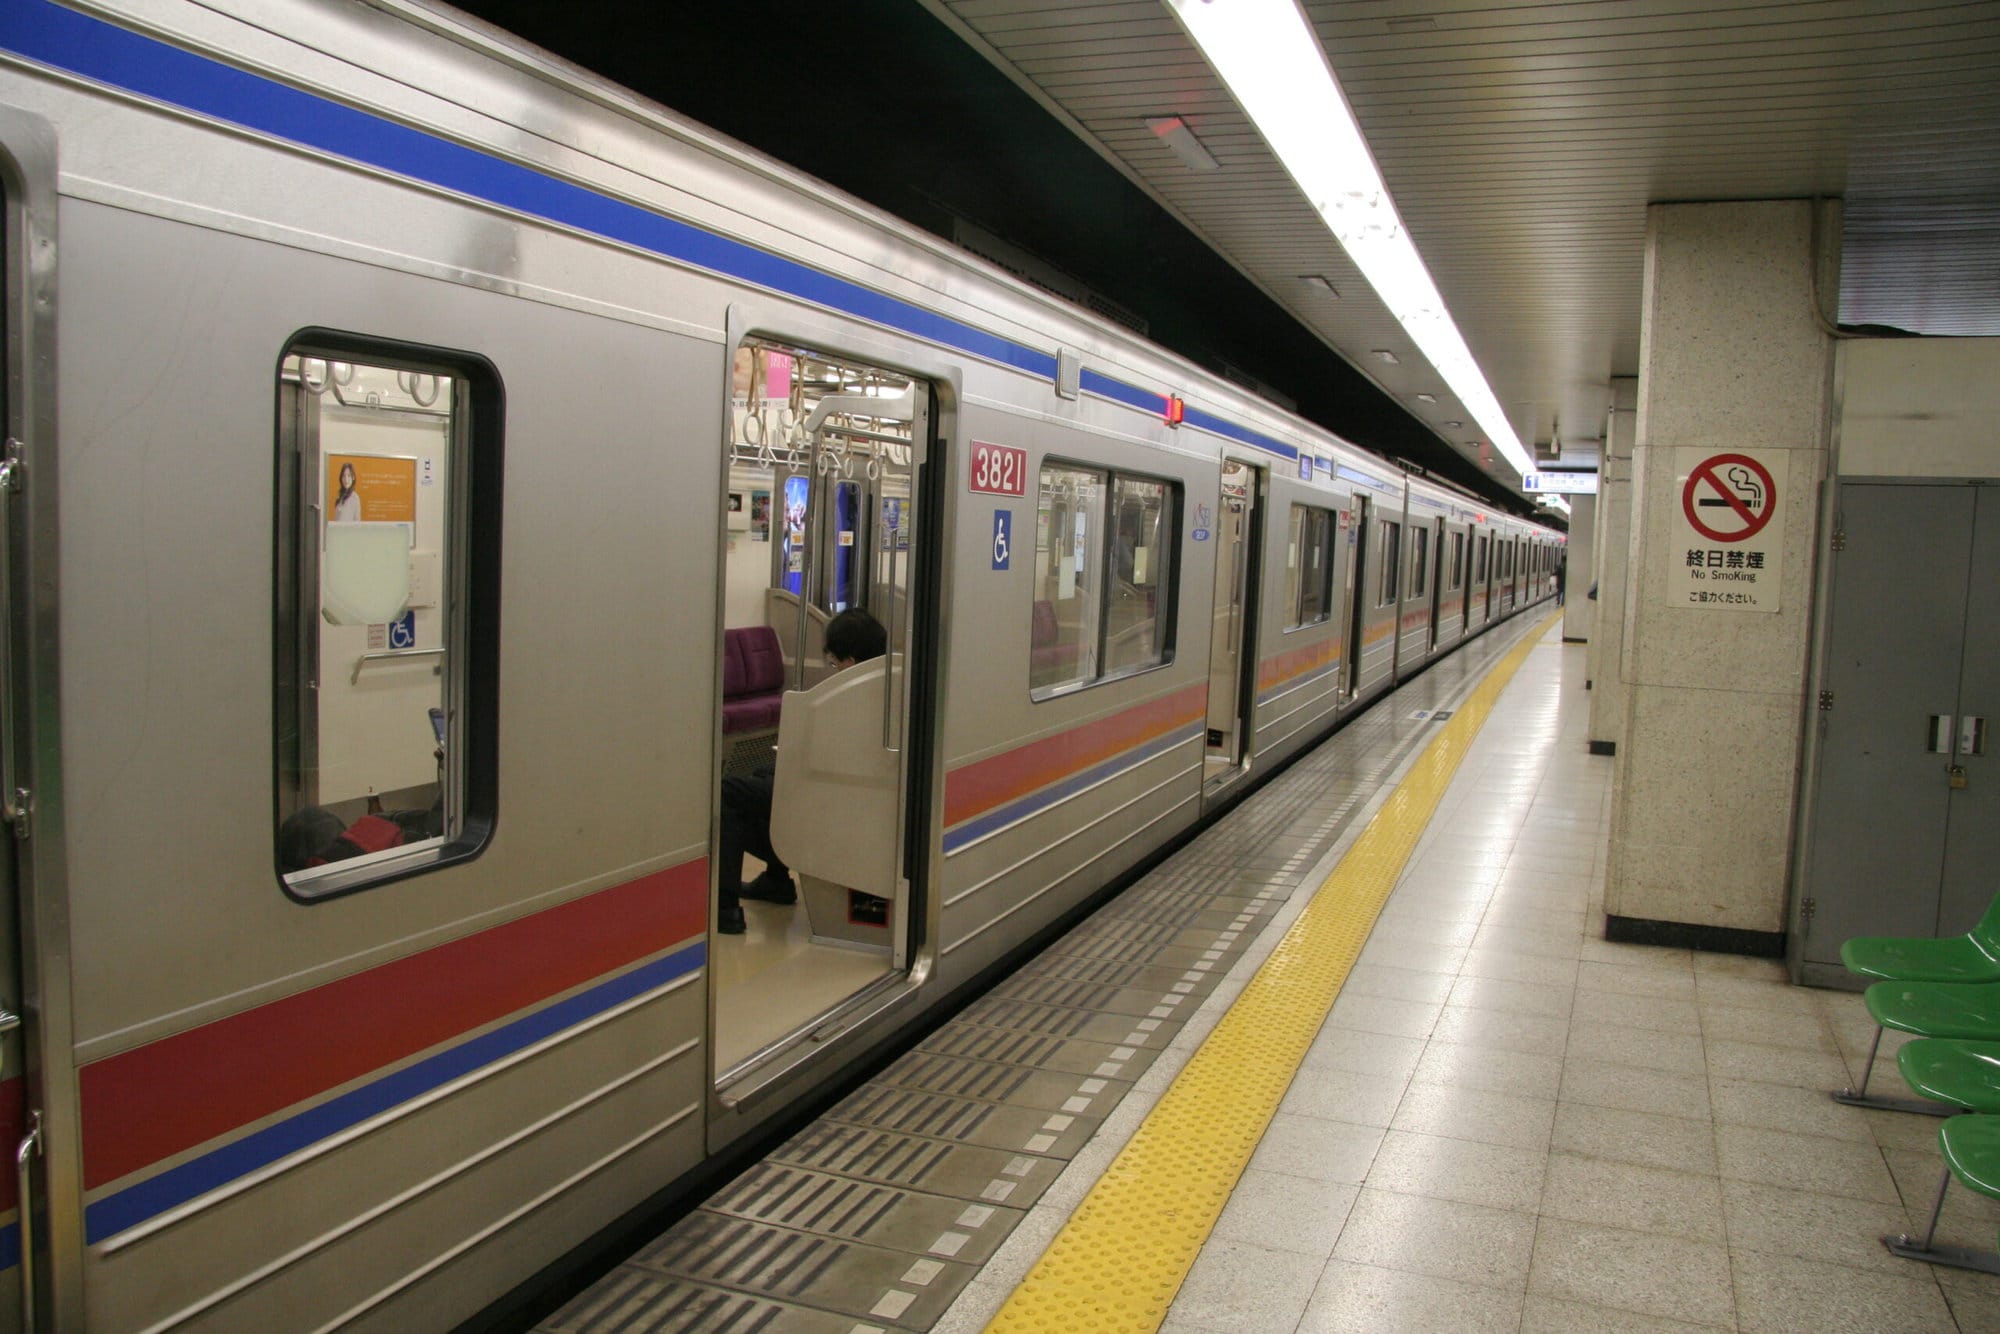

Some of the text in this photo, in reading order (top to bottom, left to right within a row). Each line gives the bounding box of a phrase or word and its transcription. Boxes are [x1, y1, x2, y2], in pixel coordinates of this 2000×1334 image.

[976, 447, 1022, 492] 3821
[1686, 549, 1765, 569] 終日禁煙
[1691, 569, 1706, 579] No
[1689, 591, 1758, 605] ご協力ください。
